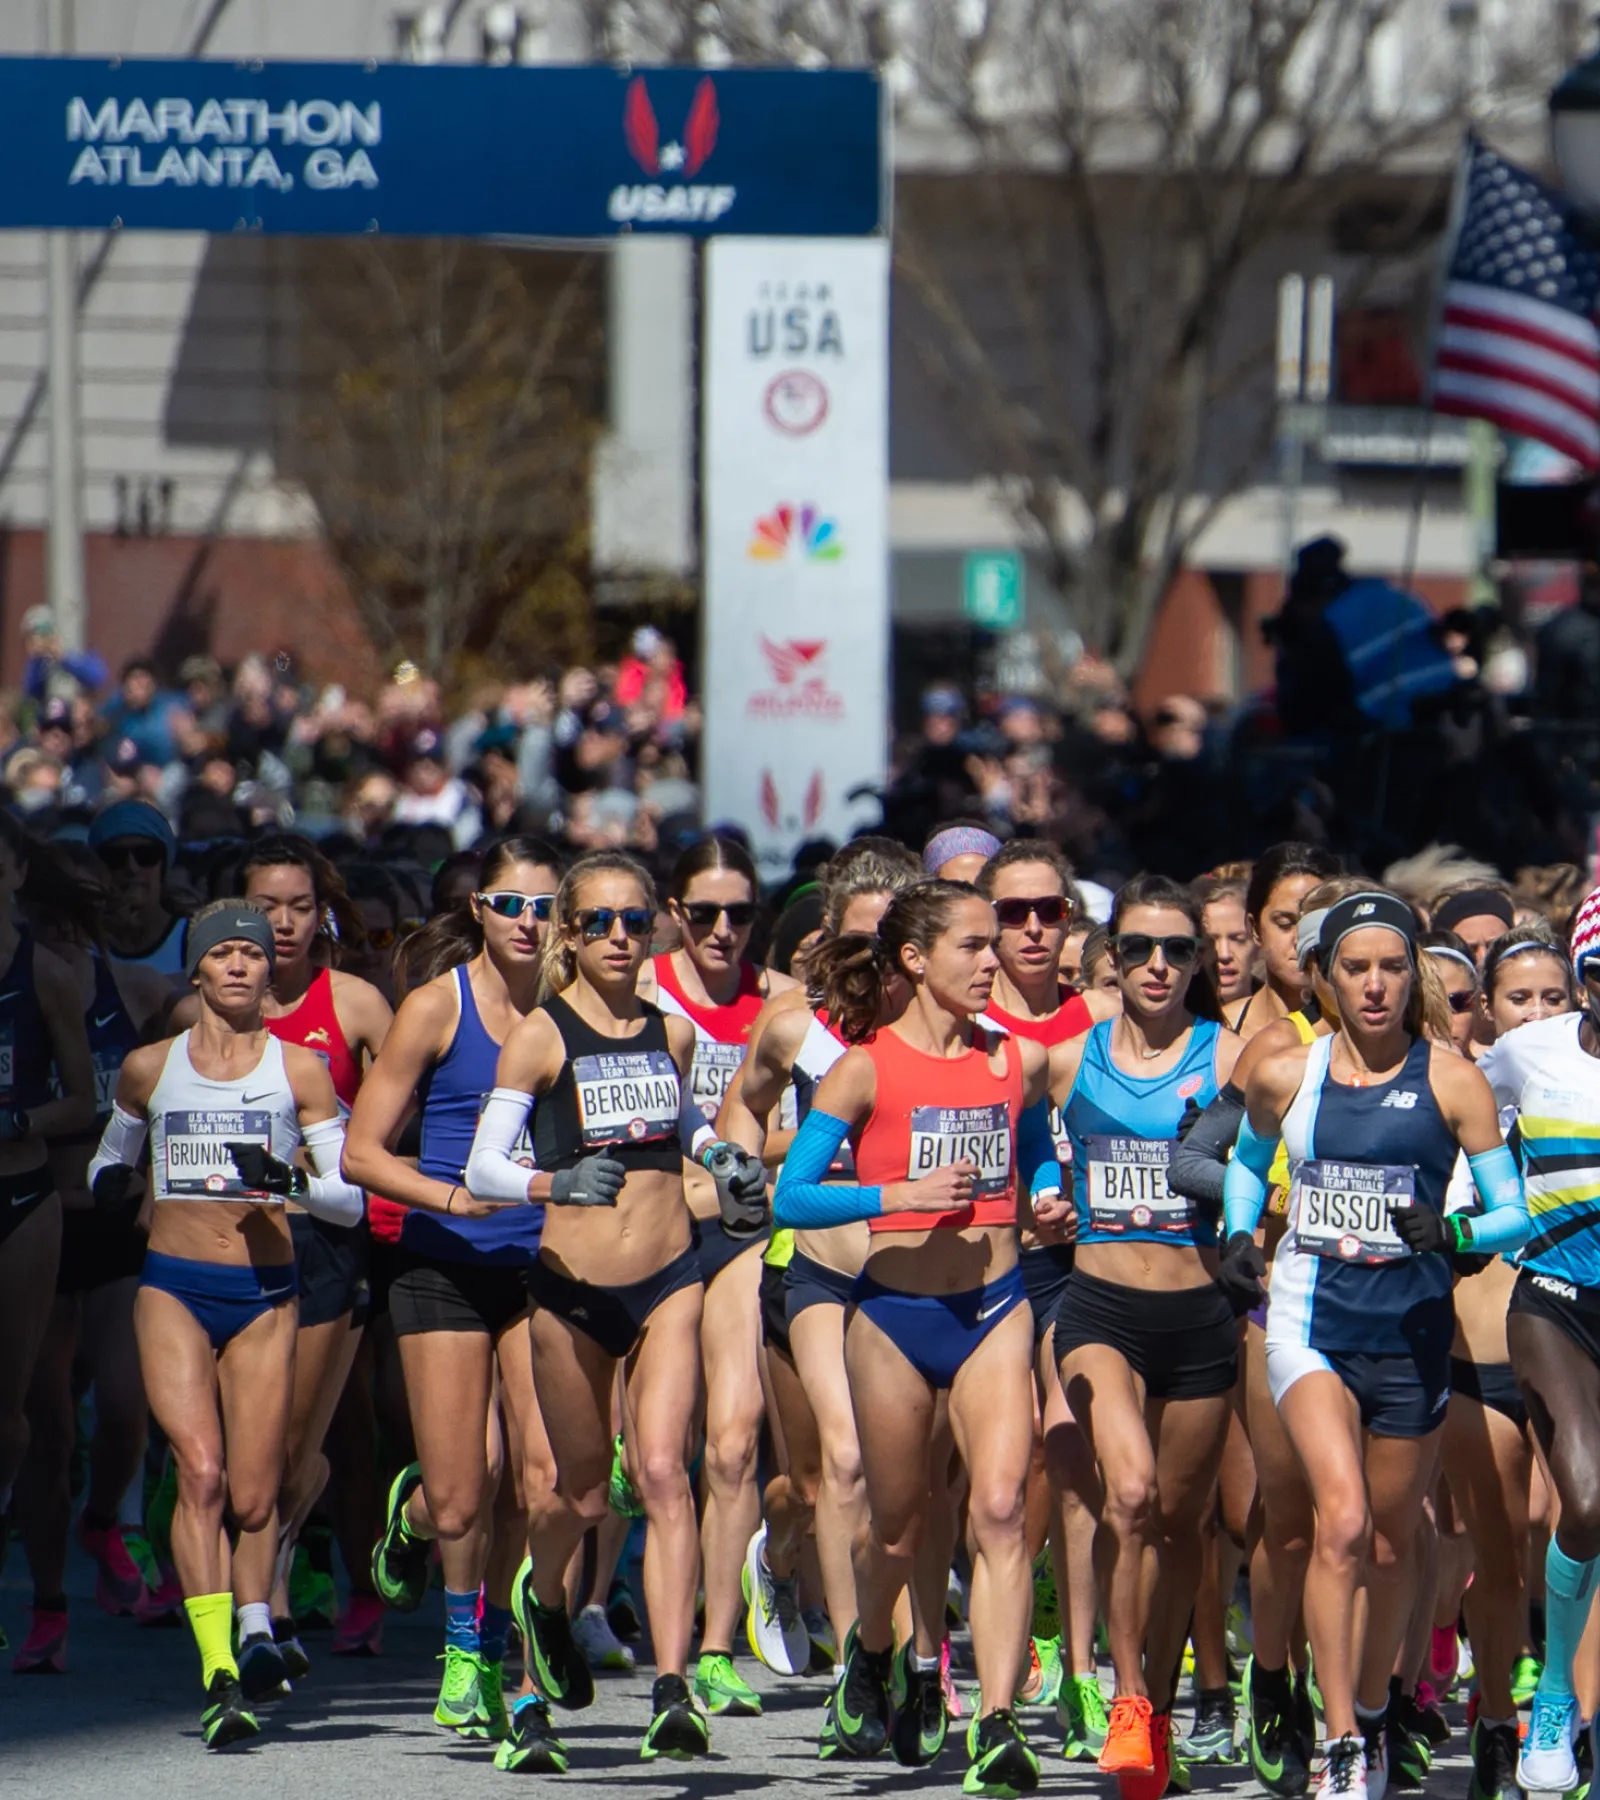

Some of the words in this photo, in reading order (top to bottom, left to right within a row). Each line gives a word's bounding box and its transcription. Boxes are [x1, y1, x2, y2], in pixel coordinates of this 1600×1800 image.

[66, 96, 381, 147] MARATHON
[67, 145, 294, 193] ATLANTA,
[304, 148, 379, 190] GA
[607, 184, 736, 222] USATF
[745, 306, 846, 360] USA
[600, 1056, 617, 1068] U.S.
[617, 1054, 649, 1068] OLYMPIC
[602, 1066, 625, 1079] TEAM
[625, 1064, 653, 1078] TRIALS
[583, 1080, 678, 1117] BERGMAN
[188, 1113, 205, 1124] U.S.
[207, 1113, 245, 1124] OLYMPIC
[940, 1109, 958, 1121] U.S.
[959, 1107, 992, 1121] OLYMPIC
[188, 1123, 212, 1134] TEAM
[214, 1123, 245, 1134] TRIALS
[940, 1120, 964, 1133] TEAM
[965, 1119, 994, 1131] TRIALS
[1111, 1139, 1129, 1152] U.S.
[1130, 1141, 1169, 1151] OLYMPIC
[1112, 1151, 1136, 1163] TEAM
[1138, 1152, 1170, 1163] TRIALS
[1323, 1164, 1341, 1178] U.S.
[1343, 1166, 1385, 1181] OLYMPIC
[1323, 1177, 1348, 1190] TEAM
[1351, 1179, 1385, 1193] TRIALS
[1308, 1190, 1398, 1232] SISSON
[1532, 1276, 1577, 1301] HOKA
